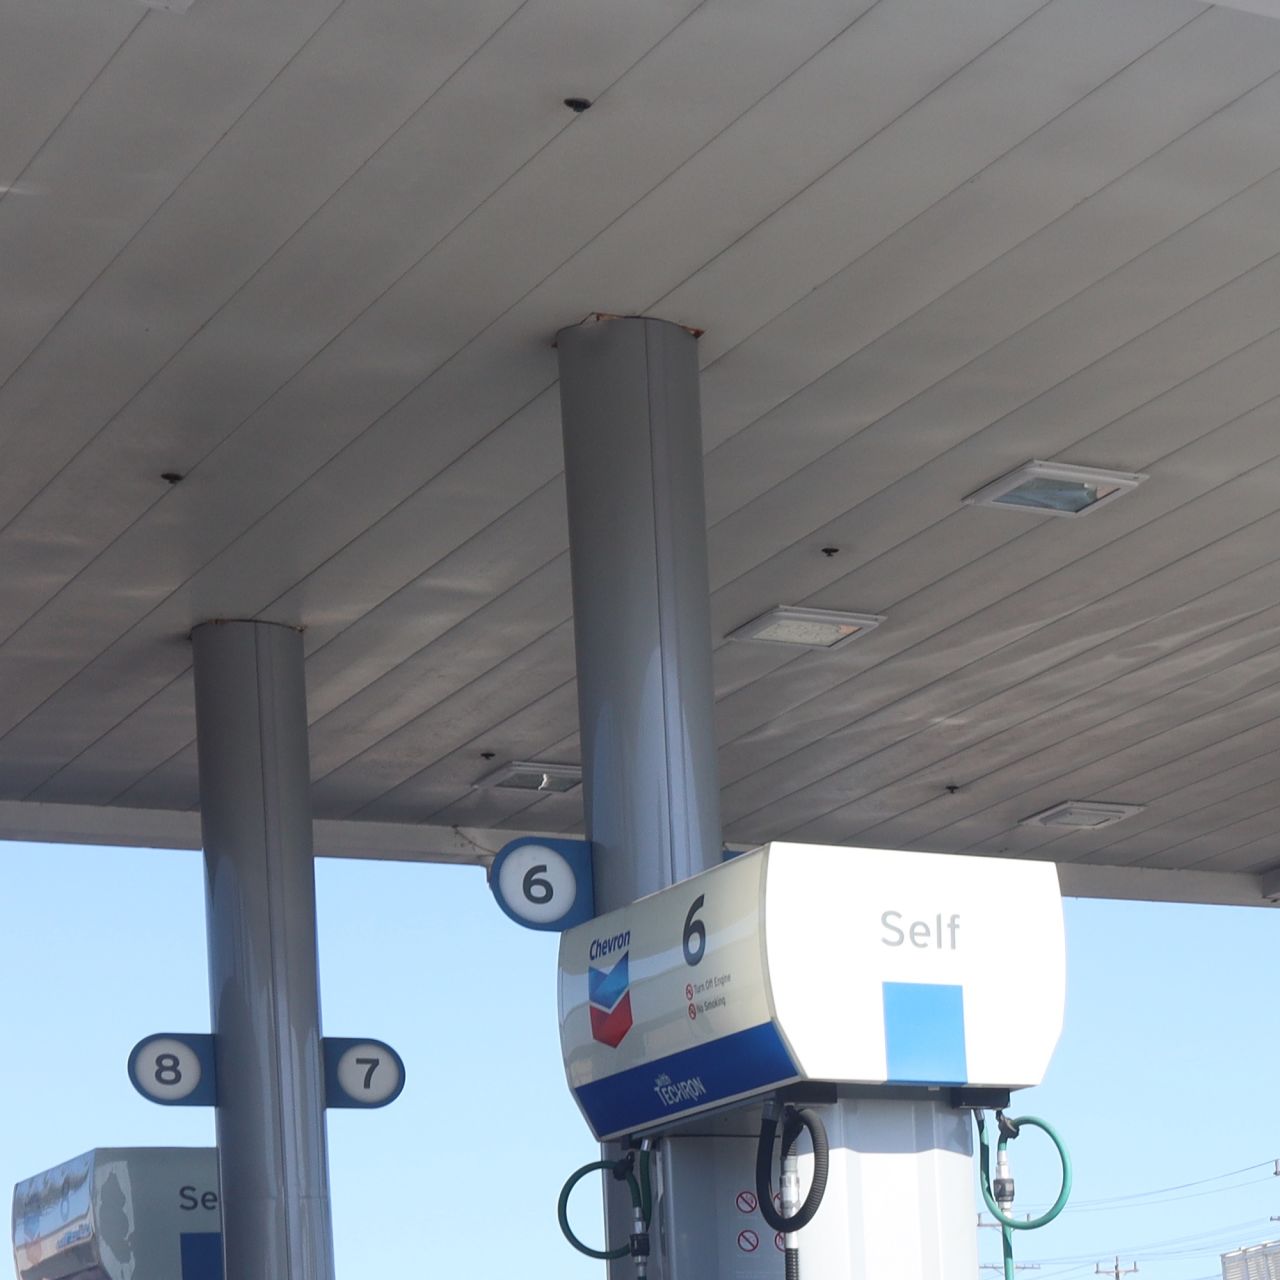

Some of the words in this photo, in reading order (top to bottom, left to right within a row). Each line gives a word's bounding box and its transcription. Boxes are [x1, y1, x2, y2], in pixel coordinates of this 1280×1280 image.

[521, 864, 555, 904] 6
[589, 930, 631, 961] Chevron
[683, 893, 706, 967] 6
[880, 909, 961, 951] Self
[704, 996, 726, 1012] Smoking
[155, 1053, 182, 1086] 8
[355, 1058, 380, 1089] 7
[179, 1185, 218, 1211] Se
